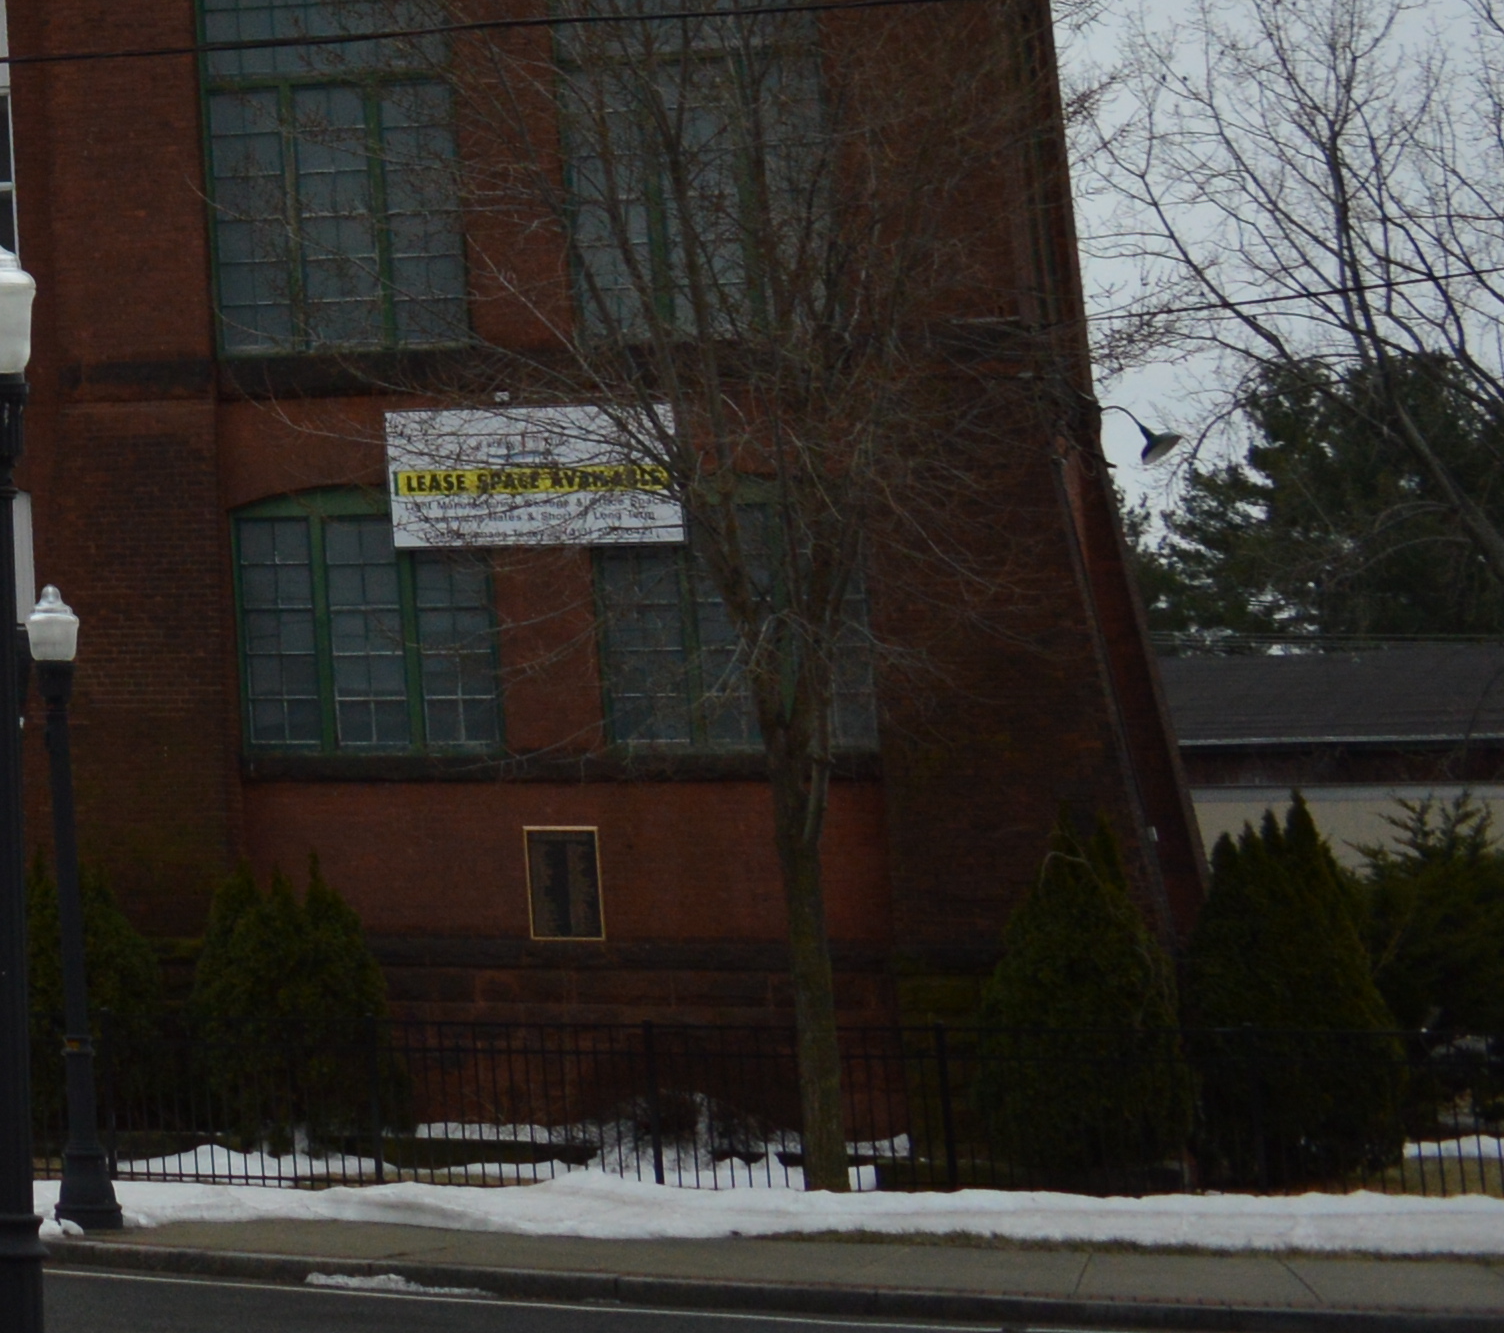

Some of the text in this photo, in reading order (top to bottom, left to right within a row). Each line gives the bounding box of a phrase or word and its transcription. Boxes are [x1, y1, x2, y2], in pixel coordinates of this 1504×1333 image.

[406, 472, 466, 493] LEASE
[476, 470, 540, 492] SPACE
[630, 494, 666, 509] Spac
